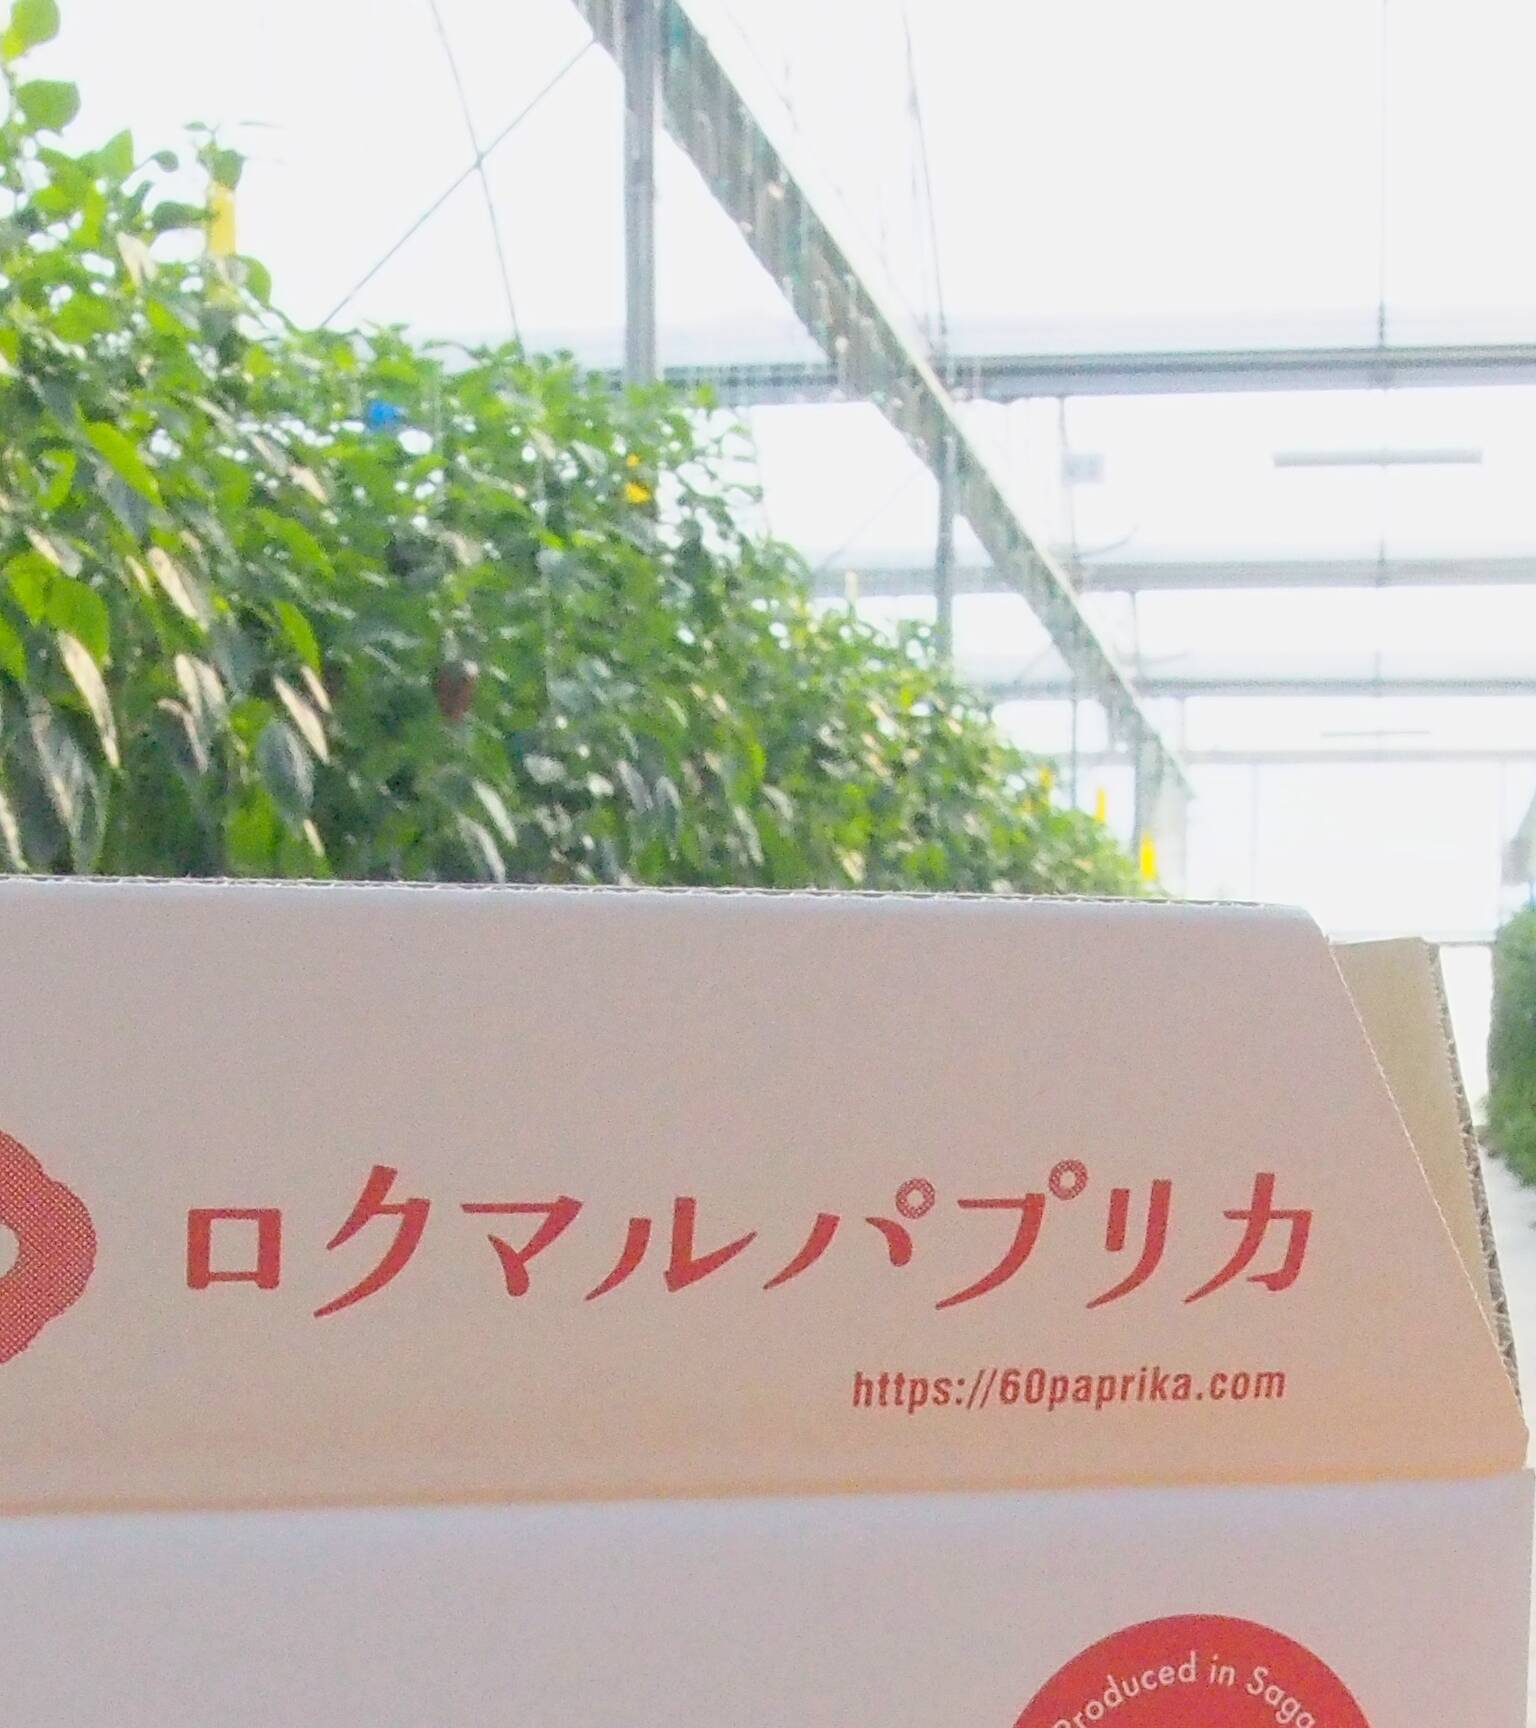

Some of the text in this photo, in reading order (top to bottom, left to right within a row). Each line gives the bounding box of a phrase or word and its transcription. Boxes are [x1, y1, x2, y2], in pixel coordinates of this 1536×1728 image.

[185, 1158, 1314, 1320] ロクマルパプリカ
[851, 1366, 1287, 1414] https://60paprika.com
[1209, 1654, 1237, 1687] in
